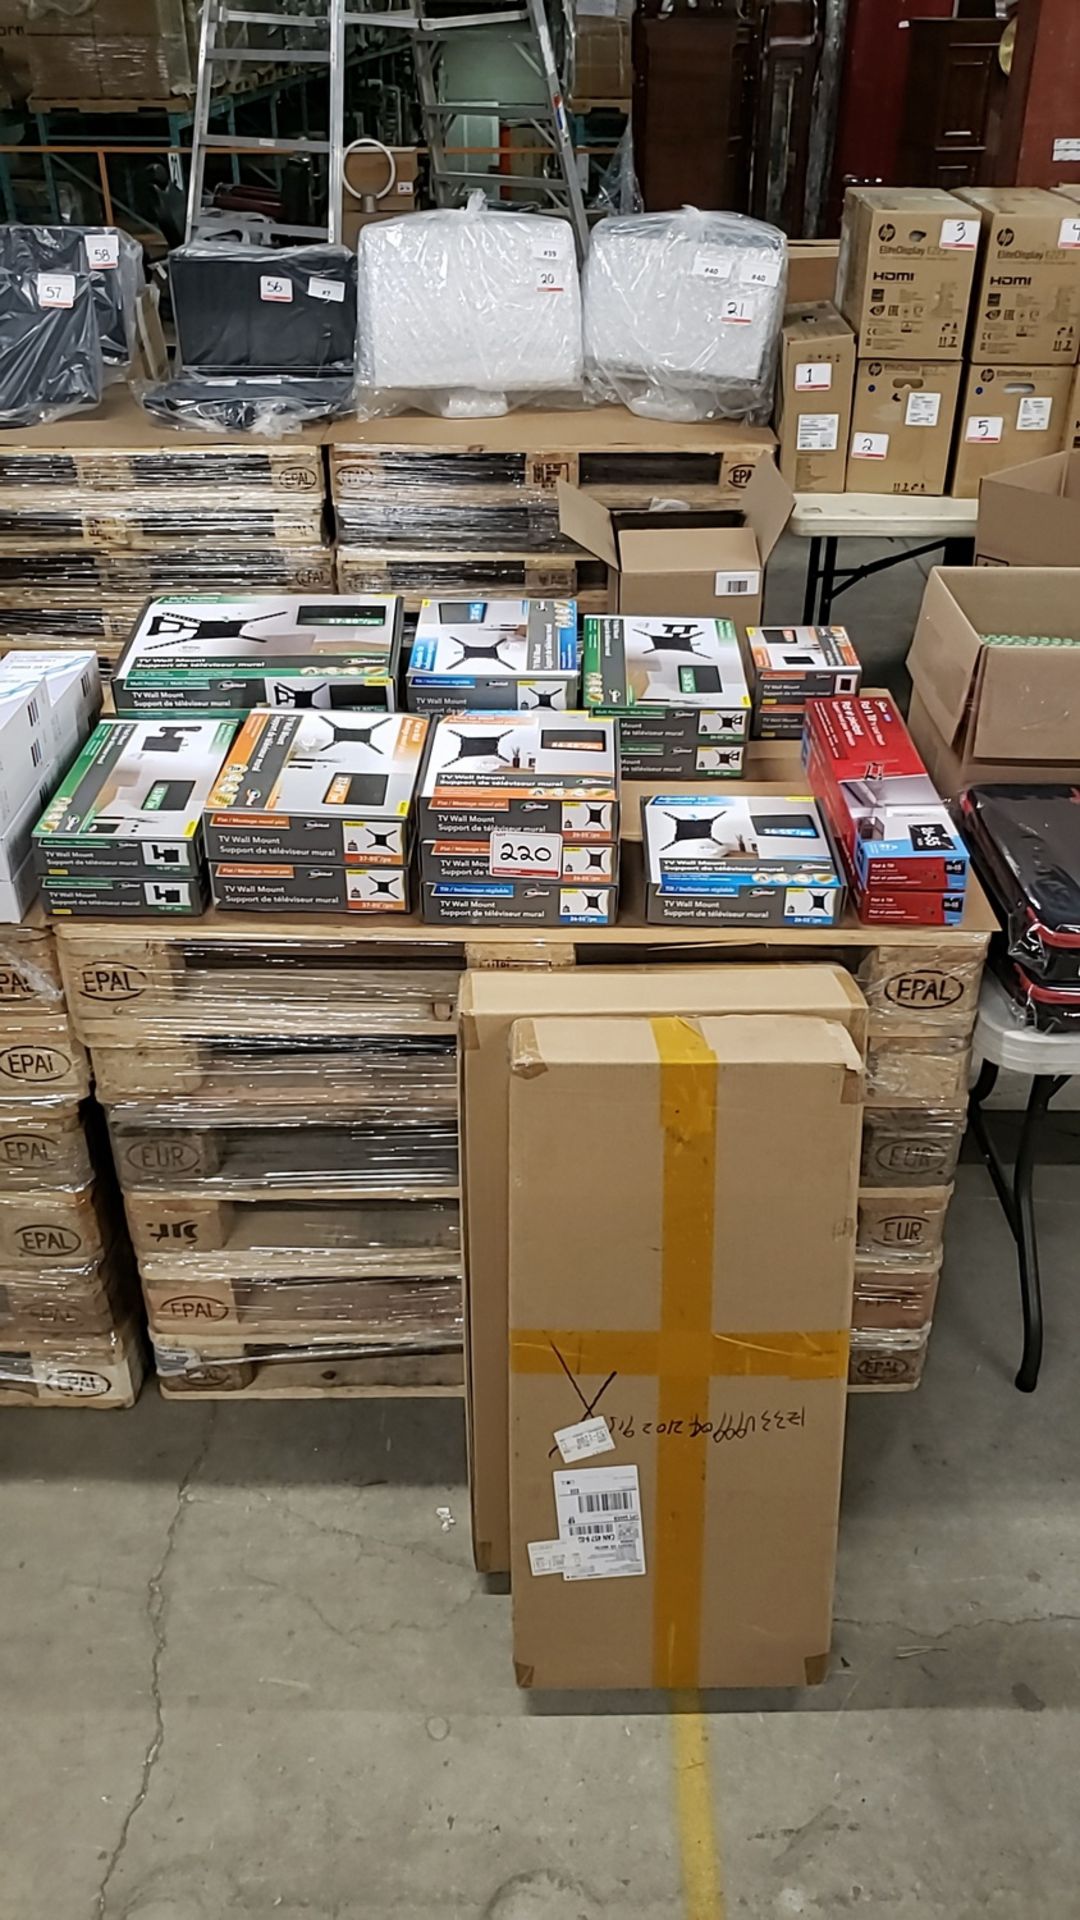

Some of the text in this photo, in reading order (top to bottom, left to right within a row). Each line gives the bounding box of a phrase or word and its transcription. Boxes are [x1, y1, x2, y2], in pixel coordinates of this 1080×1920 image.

[955, 222, 966, 242] 3
[94, 249, 110, 262] 58
[540, 273, 555, 284] 20
[873, 271, 915, 281] HDMI
[990, 276, 1032, 286] HDMI
[46, 287, 62, 298] 57
[728, 302, 744, 317] 21
[805, 368, 813, 383] 1
[978, 420, 989, 436] 5
[862, 438, 873, 451] 2
[133, 700, 231, 708] Support de téléviseur mural
[416, 697, 467, 705] TV Wall Mount
[437, 815, 495, 823] TV Wall Mount
[438, 824, 470, 833] Support
[470, 824, 482, 833] de
[218, 835, 280, 844] TV Wall Mount
[220, 846, 336, 857] Support de téléviseur mural
[500, 842, 552, 862] 220
[46, 859, 138, 867] Support de téléviseur mural
[440, 860, 469, 868] TV Wall
[441, 868, 483, 877] Support de
[224, 885, 285, 893] TV Wall Mount
[51, 899, 77, 907] Support
[78, 899, 87, 907] de
[88, 899, 121, 907] téléviseur
[225, 895, 339, 904] Support de téléviseur mural
[440, 900, 495, 909] TV Wall Mount
[664, 900, 720, 908] TV Wall Mount
[440, 909, 545, 918] Support de téléviseur mural
[664, 909, 769, 919] Support de téléviseur mural
[82, 971, 139, 992] EPAL
[896, 978, 951, 1000] EPAL
[141, 1146, 184, 1168] EUR
[888, 1146, 932, 1167] EUR
[883, 1222, 922, 1242] EUR
[22, 1232, 72, 1250] EPAL
[171, 1302, 218, 1318] EPAL
